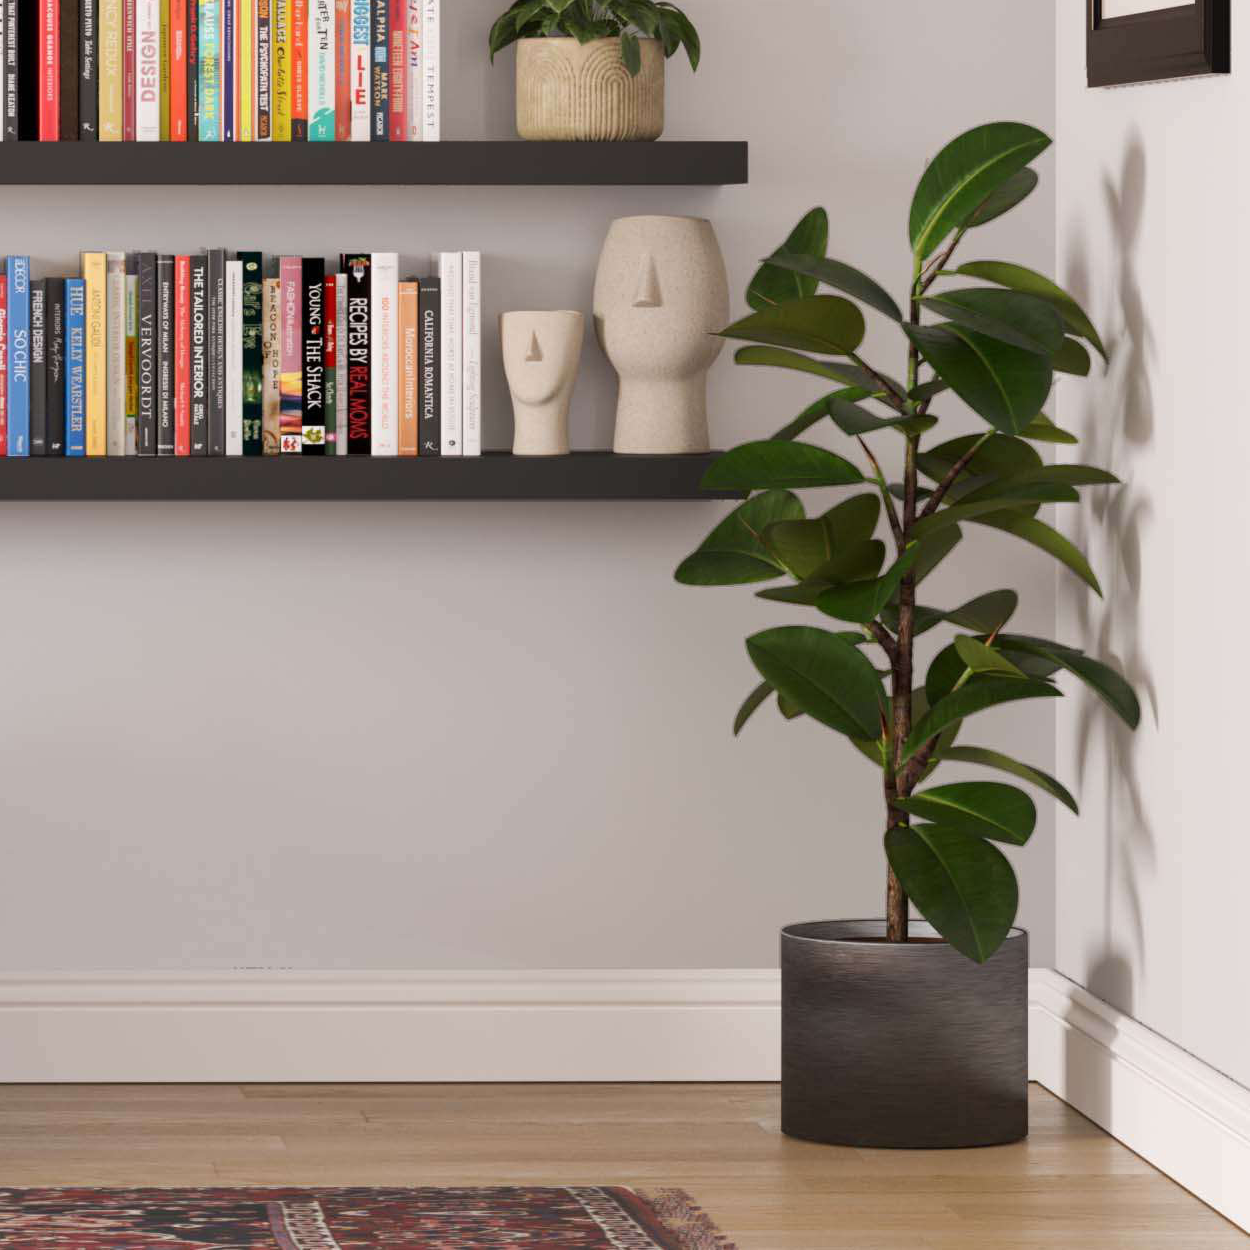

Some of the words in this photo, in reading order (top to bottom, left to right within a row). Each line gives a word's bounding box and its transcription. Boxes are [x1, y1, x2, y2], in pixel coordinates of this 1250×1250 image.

[259, 27, 269, 41] THE
[377, 1, 385, 42] ALPHA
[141, 31, 156, 102] DESIGN
[356, 55, 367, 105] LIE
[259, 93, 269, 111] TEST
[194, 267, 203, 287] THE
[33, 290, 43, 327] FRENCH
[71, 286, 82, 316] HUE
[194, 289, 203, 344] TAILORED
[309, 283, 321, 324] YOUNG
[14, 329, 26, 349] SO
[162, 321, 168, 331] OF
[349, 298, 368, 345] RECIPES
[424, 310, 434, 364] CALIFORNIA
[33, 330, 43, 363] DESIGN
[71, 327, 82, 362] KELLY
[306, 338, 323, 364] THE
[349, 349, 368, 363] BY
[14, 351, 26, 382] CHIC
[141, 314, 151, 419] VERVOORDT
[194, 346, 203, 398] INTERIOR
[349, 366, 368, 395] REAL
[71, 366, 82, 431] WEARSTLER
[306, 366, 323, 409] SHACK
[424, 367, 434, 419] ROMANTICA
[349, 398, 368, 439] MOMS
